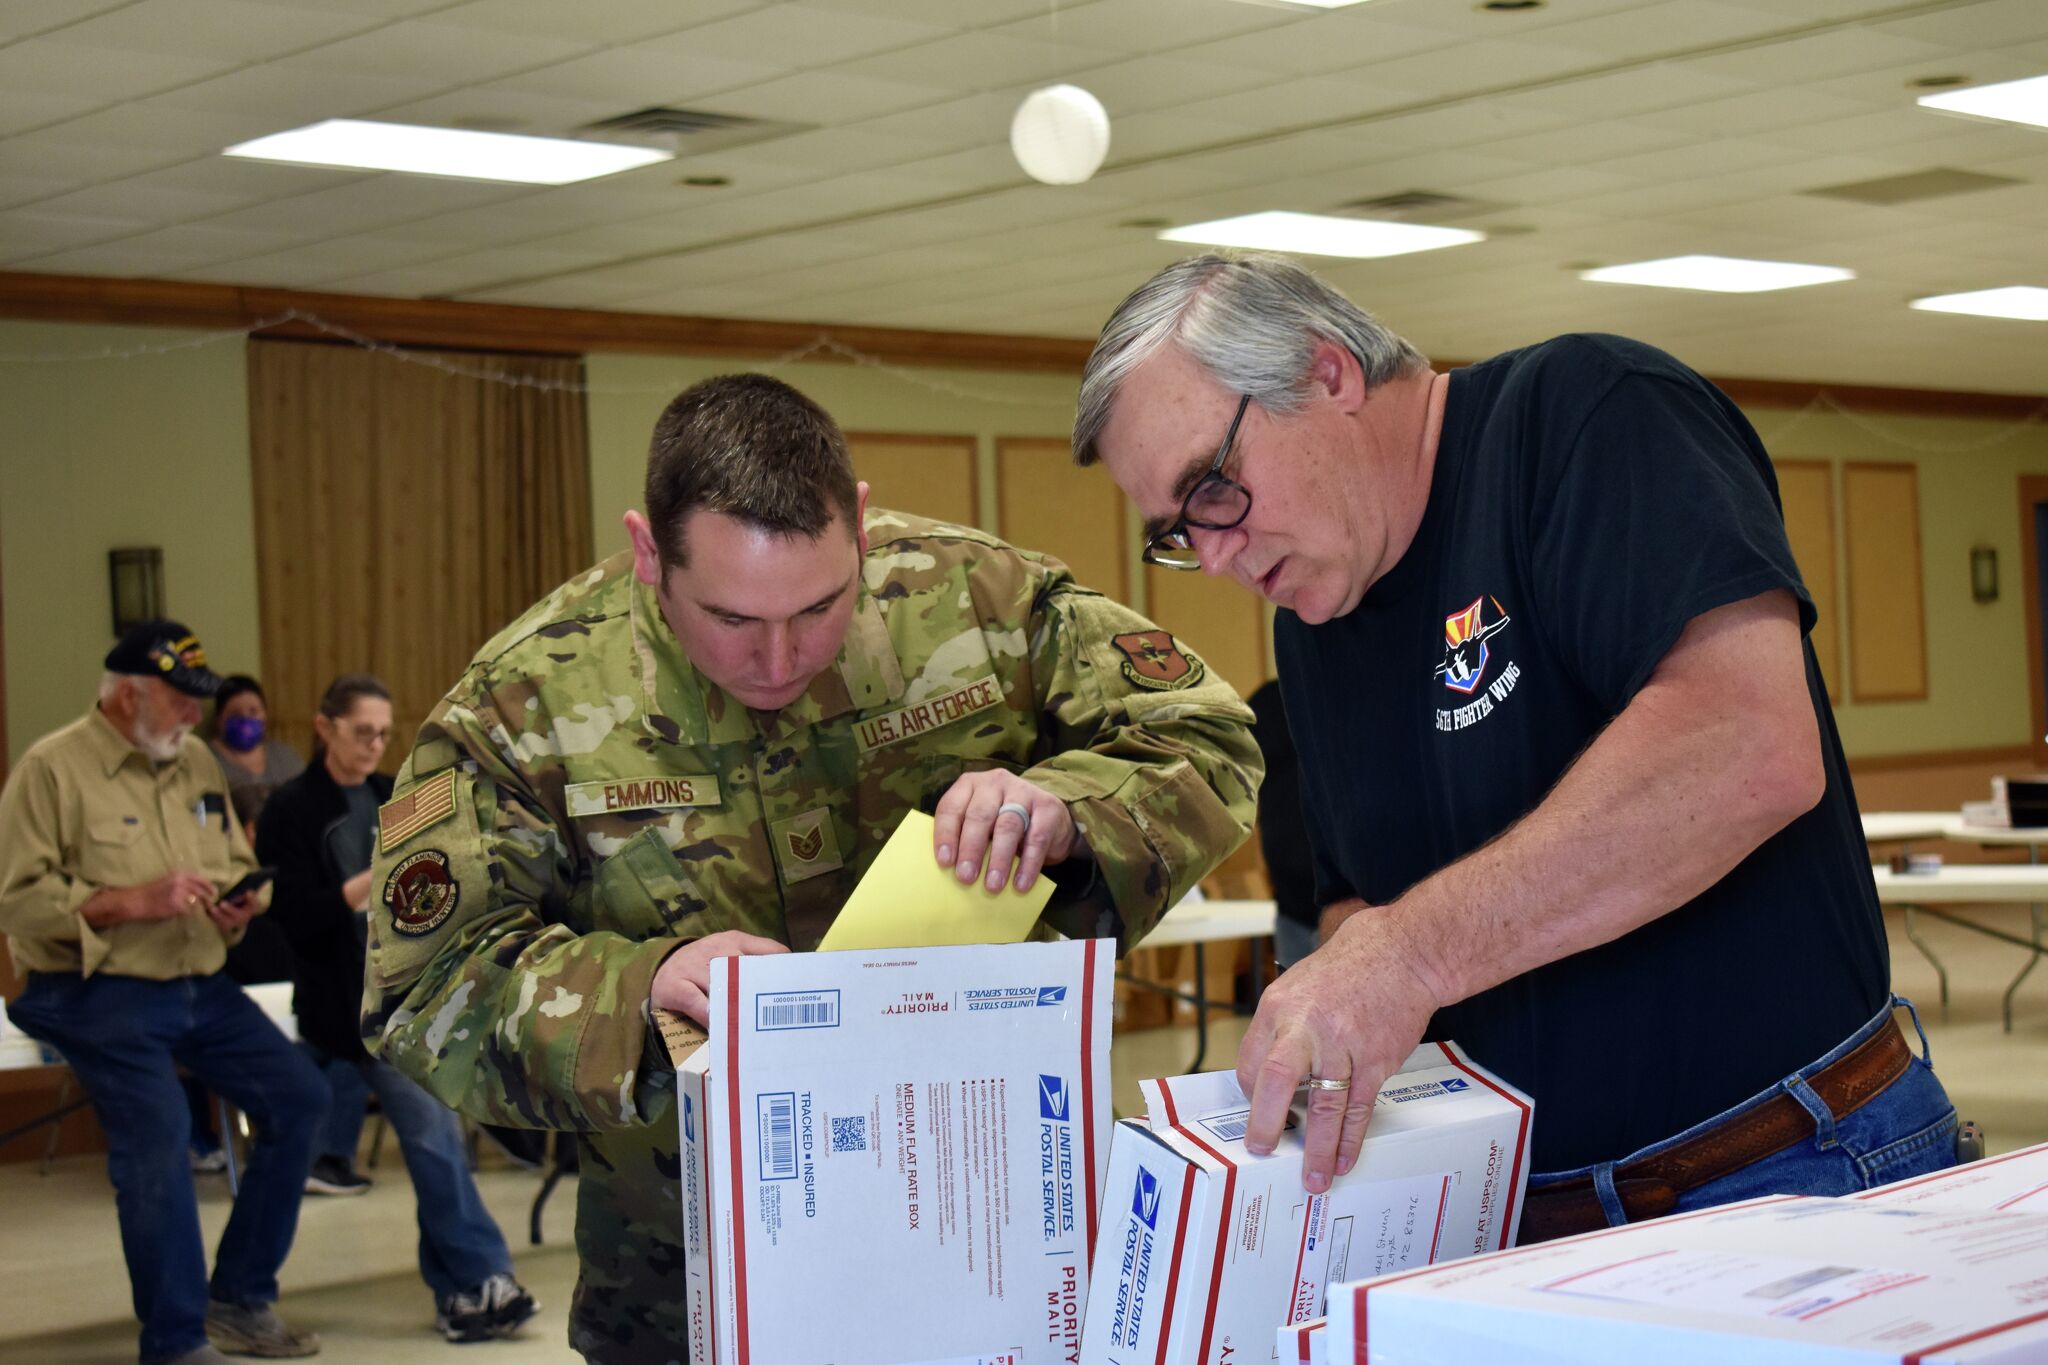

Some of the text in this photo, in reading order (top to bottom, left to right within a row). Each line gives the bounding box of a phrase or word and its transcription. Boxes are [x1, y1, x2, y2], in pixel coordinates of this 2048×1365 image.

[861, 681, 997, 748] U.S. AIR FORCE
[1436, 661, 1521, 731] 56TH FIGHTER WING
[604, 780, 694, 810] EMMONS
[901, 992, 933, 1001] MAIL
[968, 1000, 1033, 1010] UNITED STATES
[1004, 987, 1036, 996] POSTAL
[1391, 1088, 1447, 1103] UNITED STATES
[1411, 1082, 1439, 1092] POSTAL
[801, 1091, 815, 1217] TRACKED INSURED
[897, 1146, 905, 1174] WEIGHT
[903, 1082, 919, 1230] MEDIUM FLAT RATE BOX
[1040, 1123, 1053, 1176] POSTAL
[993, 1180, 998, 1188] up
[1059, 1125, 1073, 1231] UNITED STATES
[1254, 1194, 1262, 1224] REQUIRED
[1482, 1145, 1504, 1252] FREE SUPPLIES ONLINE
[1473, 1235, 1483, 1254] US
[1477, 1217, 1486, 1232] AT
[1122, 1218, 1139, 1277] POSTAL
[1129, 1232, 1153, 1350] UNITED STATES
[1047, 1291, 1060, 1342] MAIL
[1062, 1266, 1078, 1364] PRIORITY
